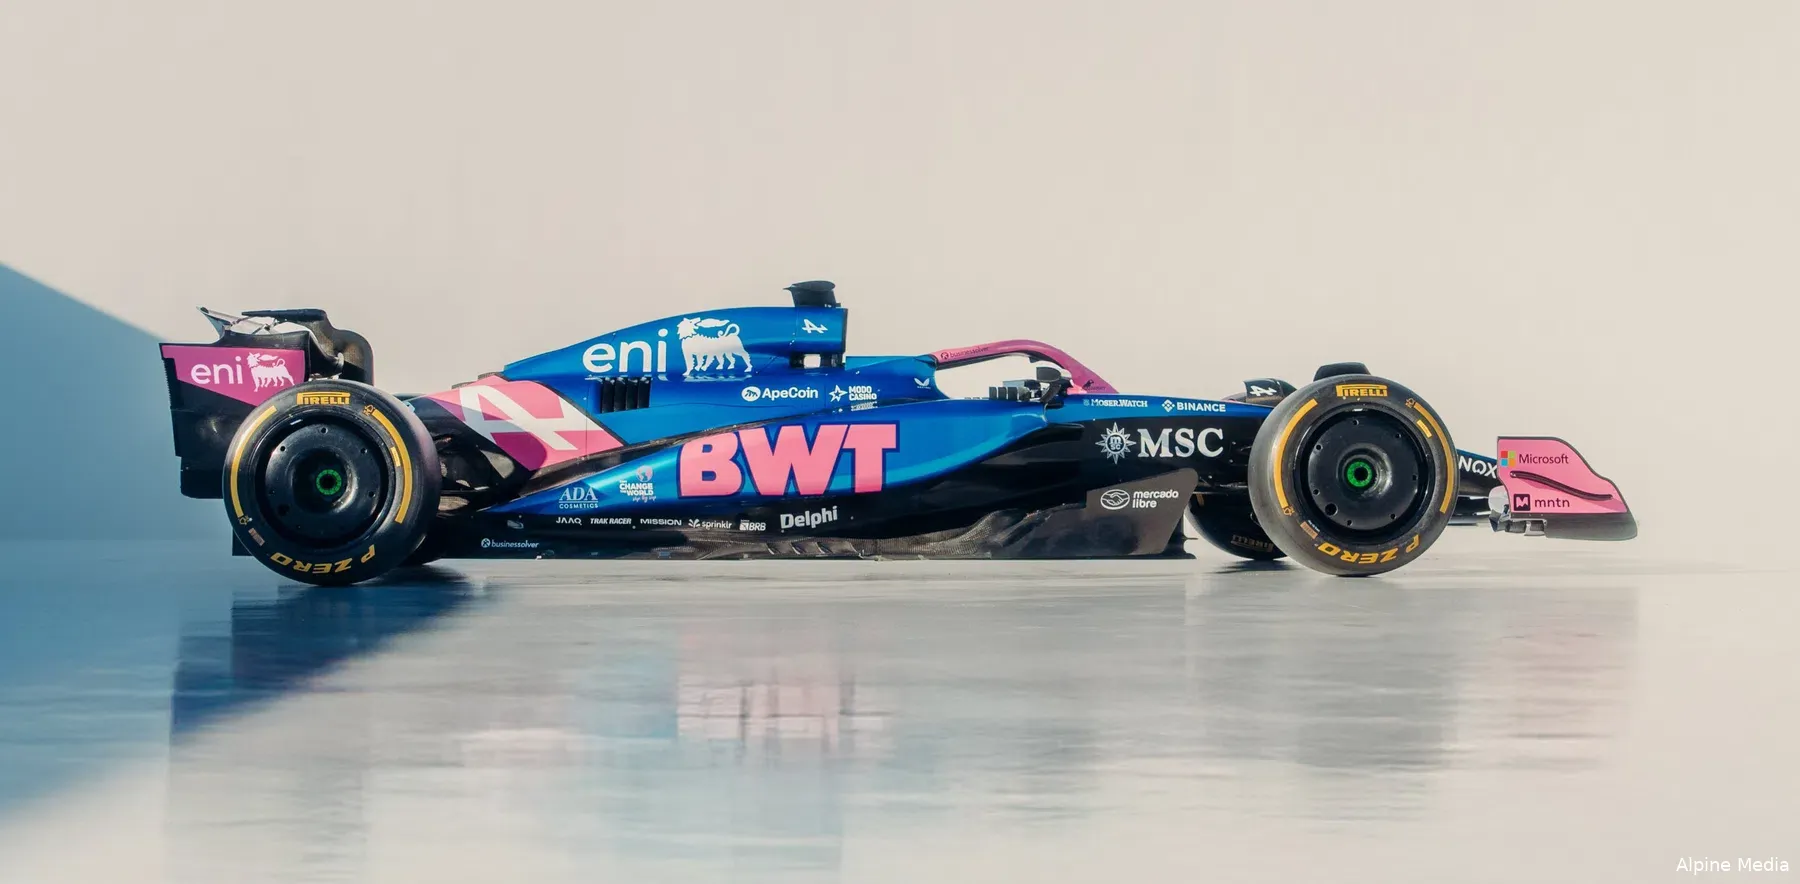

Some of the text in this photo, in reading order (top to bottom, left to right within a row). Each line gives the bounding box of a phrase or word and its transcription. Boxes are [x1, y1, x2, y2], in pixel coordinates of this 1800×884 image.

[582, 328, 669, 374] eni
[190, 356, 243, 385] eni
[762, 387, 819, 401] ApeCoin
[848, 385, 872, 393] MODO
[1335, 384, 1389, 397] PIRELLI
[296, 392, 351, 405] PIRELLI
[848, 393, 878, 401] CASINO
[1176, 401, 1226, 412] BINANCE
[1136, 427, 1225, 458] MSC
[679, 423, 897, 496] BWT
[1518, 453, 1569, 465] Microsoft
[1457, 455, 1498, 479] NOX
[619, 482, 654, 490] CHANGE
[558, 487, 599, 501] ADA
[1132, 489, 1179, 499] mercado
[1132, 499, 1158, 509] libre
[1534, 498, 1570, 508] mntn
[590, 517, 632, 525] TRAK RACER
[640, 518, 682, 526] MISSION
[780, 505, 839, 530] Delphi
[701, 520, 733, 531] sprinklr
[749, 522, 767, 531] BRB
[491, 539, 539, 548] businessolver
[1317, 534, 1421, 564] P ZERO
[269, 544, 376, 574] P ZERO
